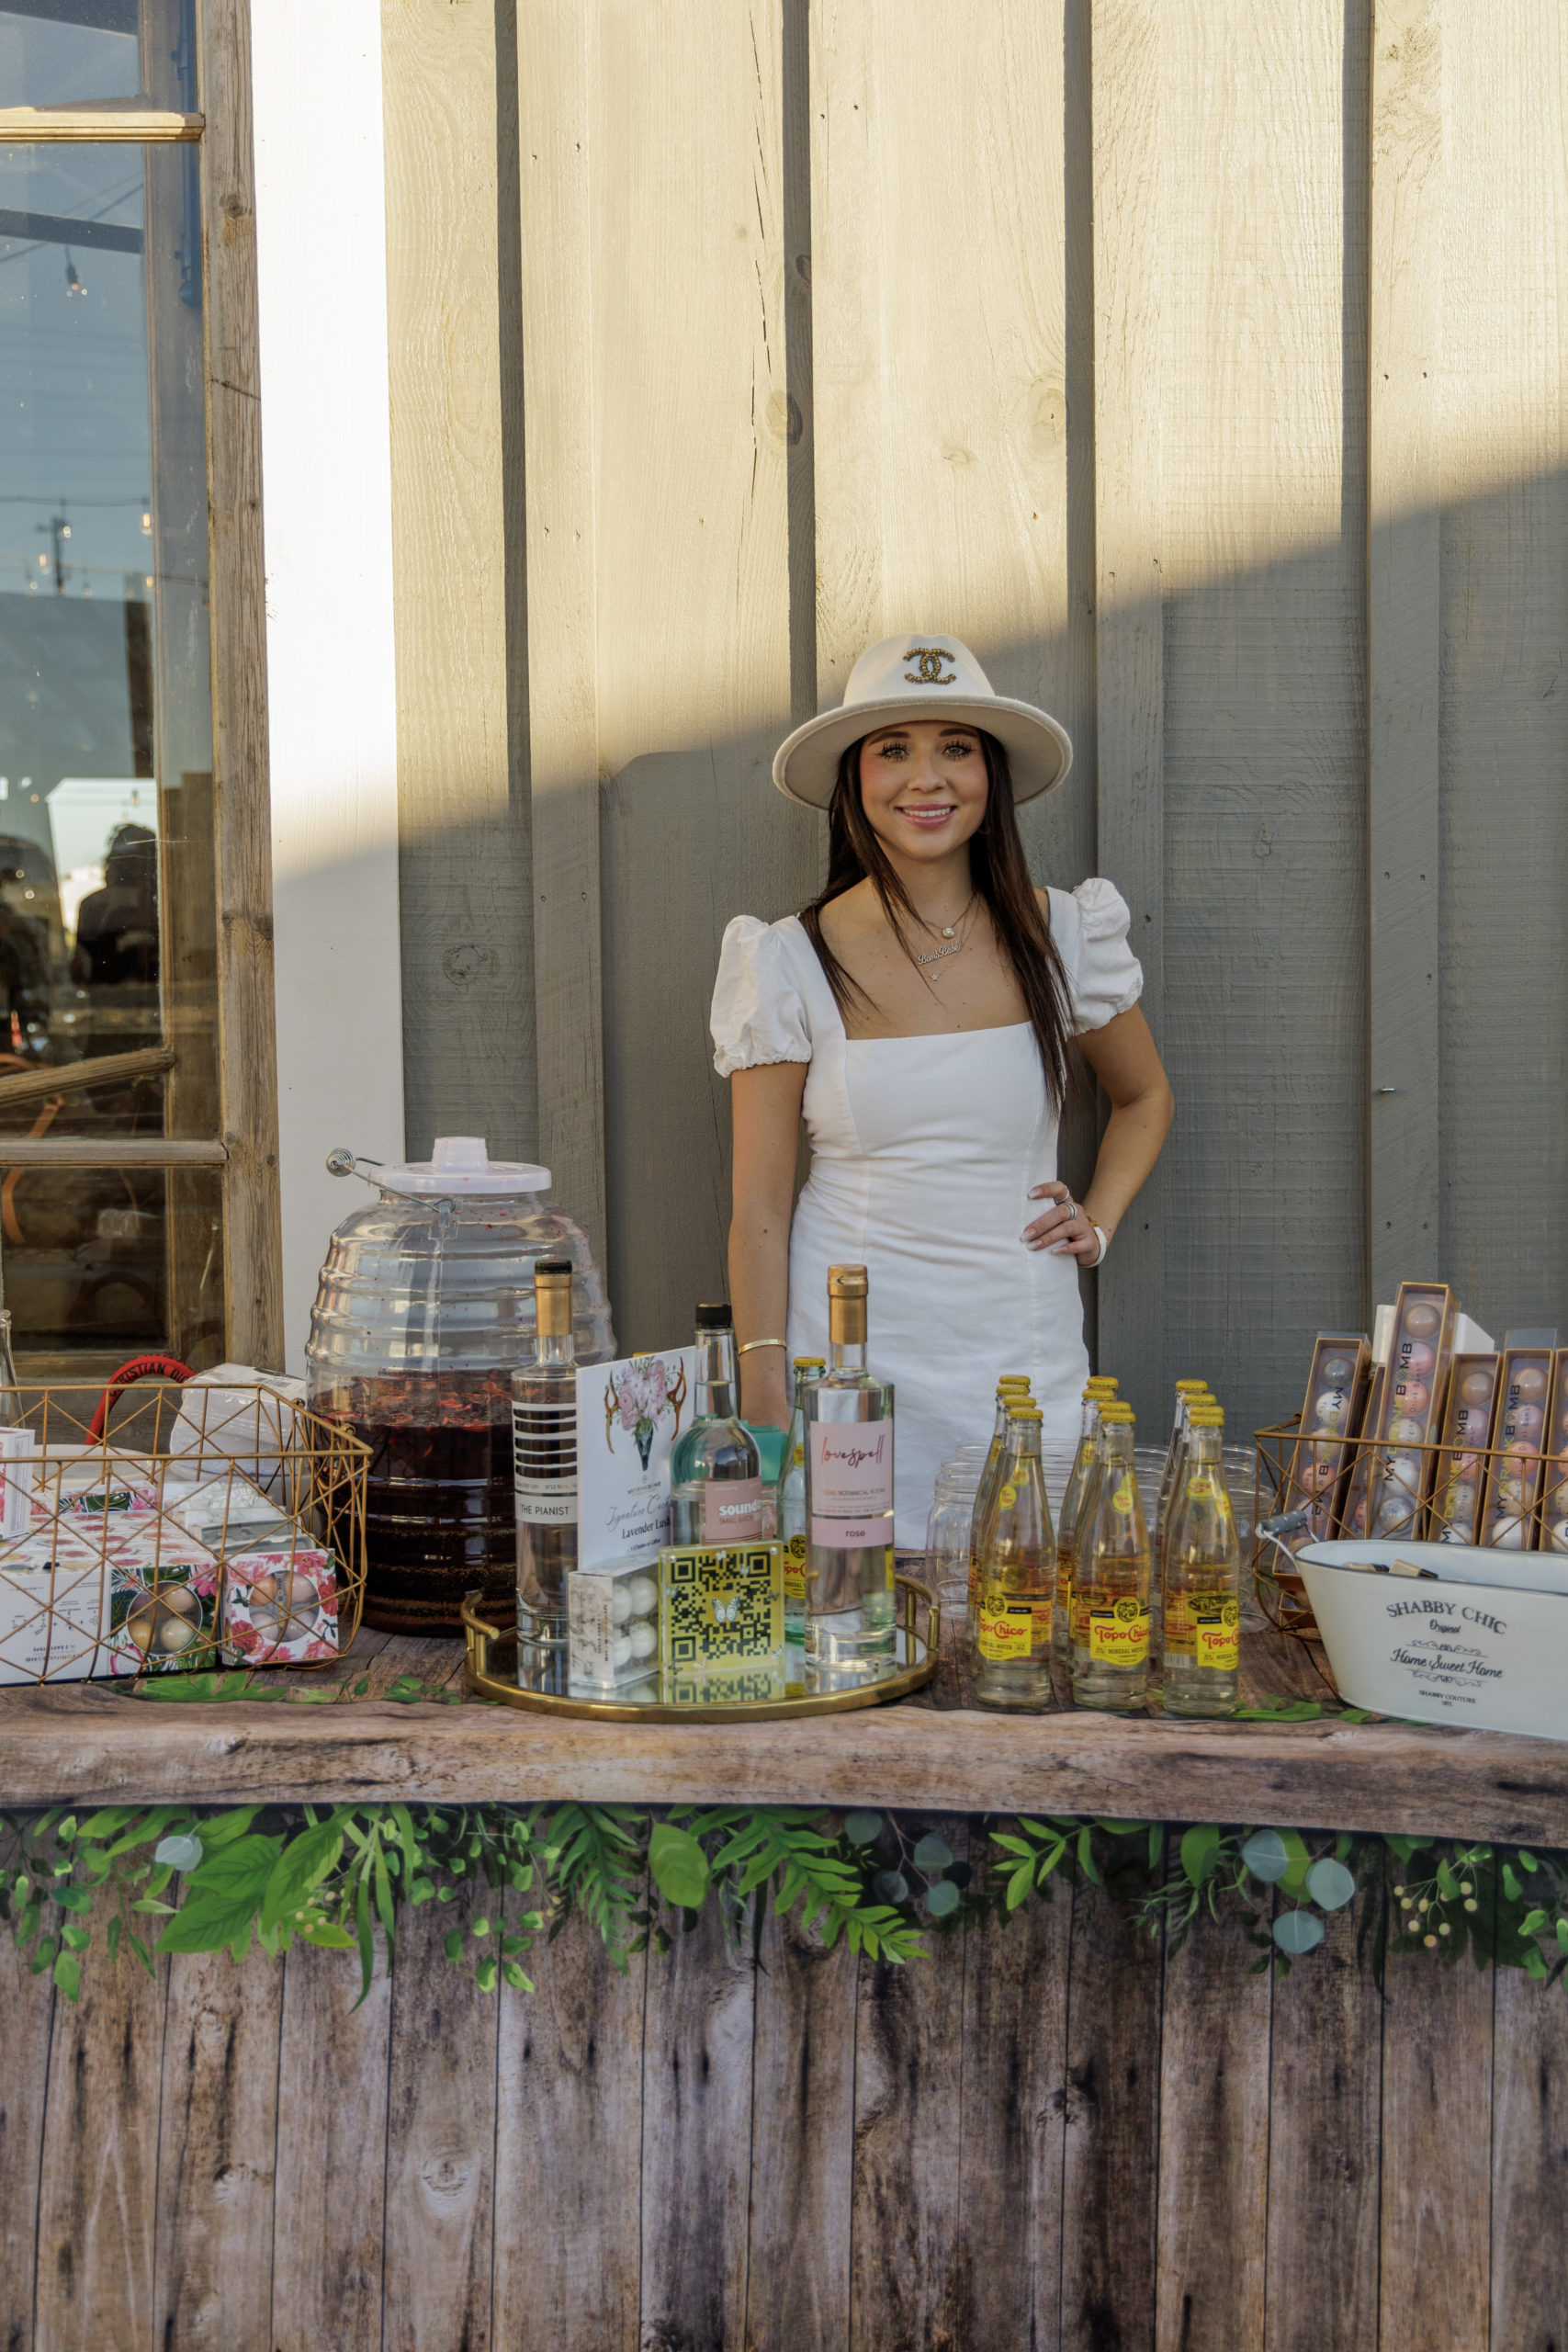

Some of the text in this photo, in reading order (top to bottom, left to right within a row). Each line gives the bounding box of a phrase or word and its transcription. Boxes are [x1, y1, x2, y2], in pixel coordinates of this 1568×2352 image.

[109, 1362, 166, 1397] CRISTIAN
[821, 1434, 886, 1469] lovespell
[1311, 1385, 1345, 1516] MYDRNKBOMB
[520, 1502, 570, 1516] THE PIANIST
[622, 1522, 654, 1540] Lavender
[845, 1529, 866, 1538] rose
[1386, 1600, 1507, 1635] SHABBY CHIC
[1429, 1618, 1461, 1634] Original
[993, 1620, 1028, 1639] Chico
[1094, 1624, 1127, 1643] Topo
[1201, 1631, 1233, 1650] Topo
[1390, 1647, 1504, 1679] Home Sweet Home
[1444, 1694, 1477, 1705] COUTURE
